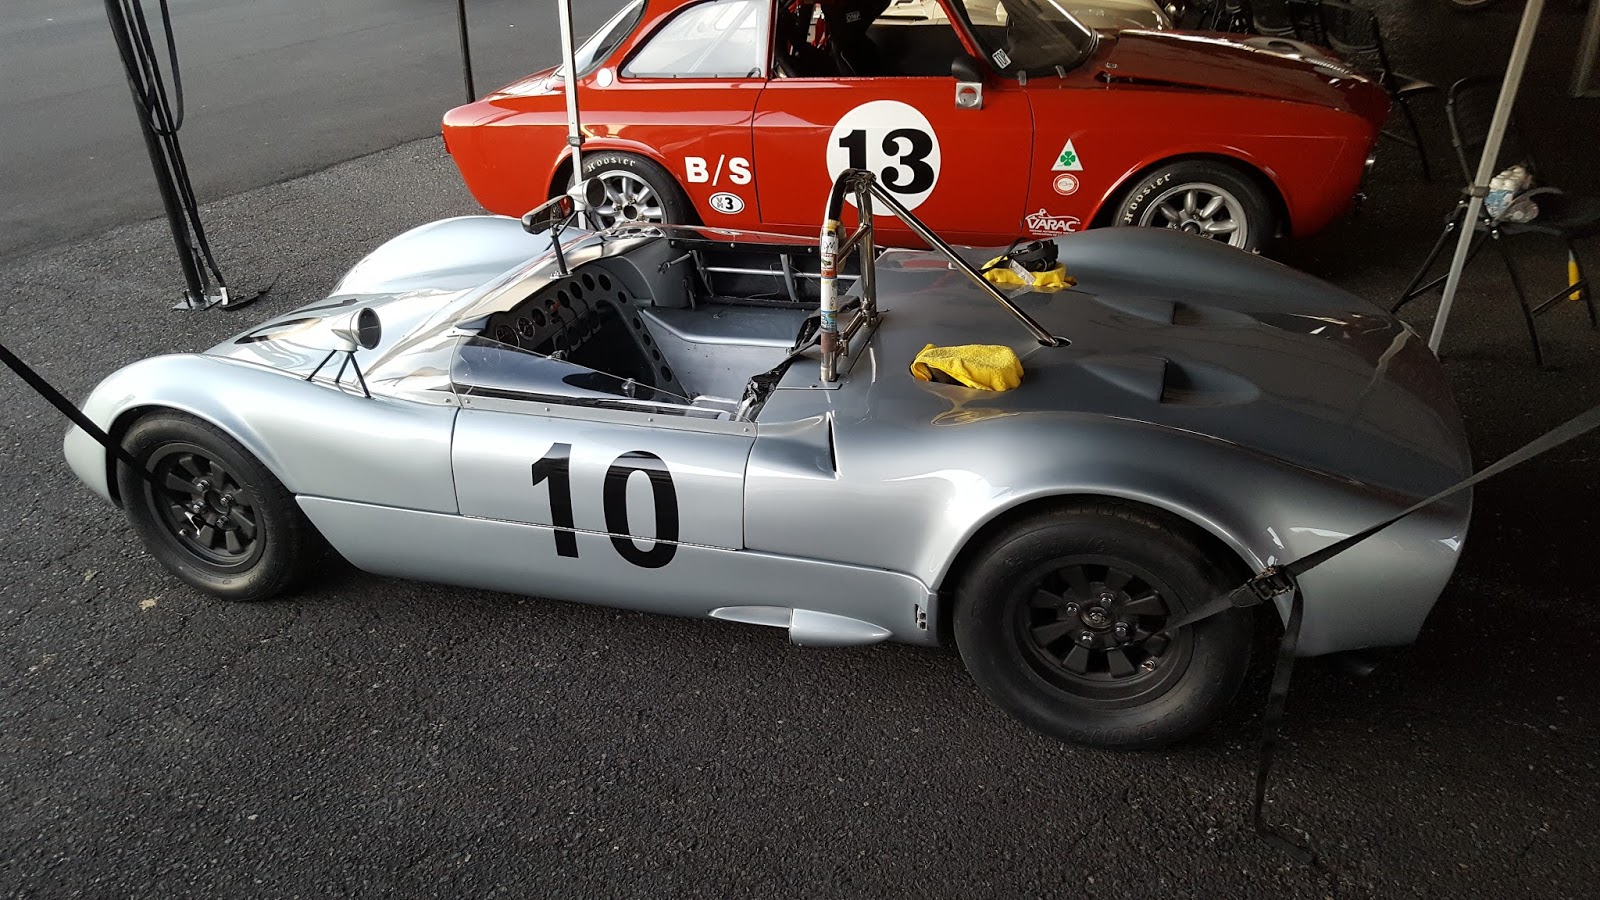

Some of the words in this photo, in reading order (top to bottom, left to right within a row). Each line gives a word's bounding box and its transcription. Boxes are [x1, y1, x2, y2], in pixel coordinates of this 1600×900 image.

[587, 156, 636, 173] Hoosier
[684, 154, 752, 186] B/S
[839, 128, 934, 194] 13
[1124, 173, 1171, 224] Hoosier
[1027, 218, 1076, 232] VARAC
[531, 442, 679, 568] 10
